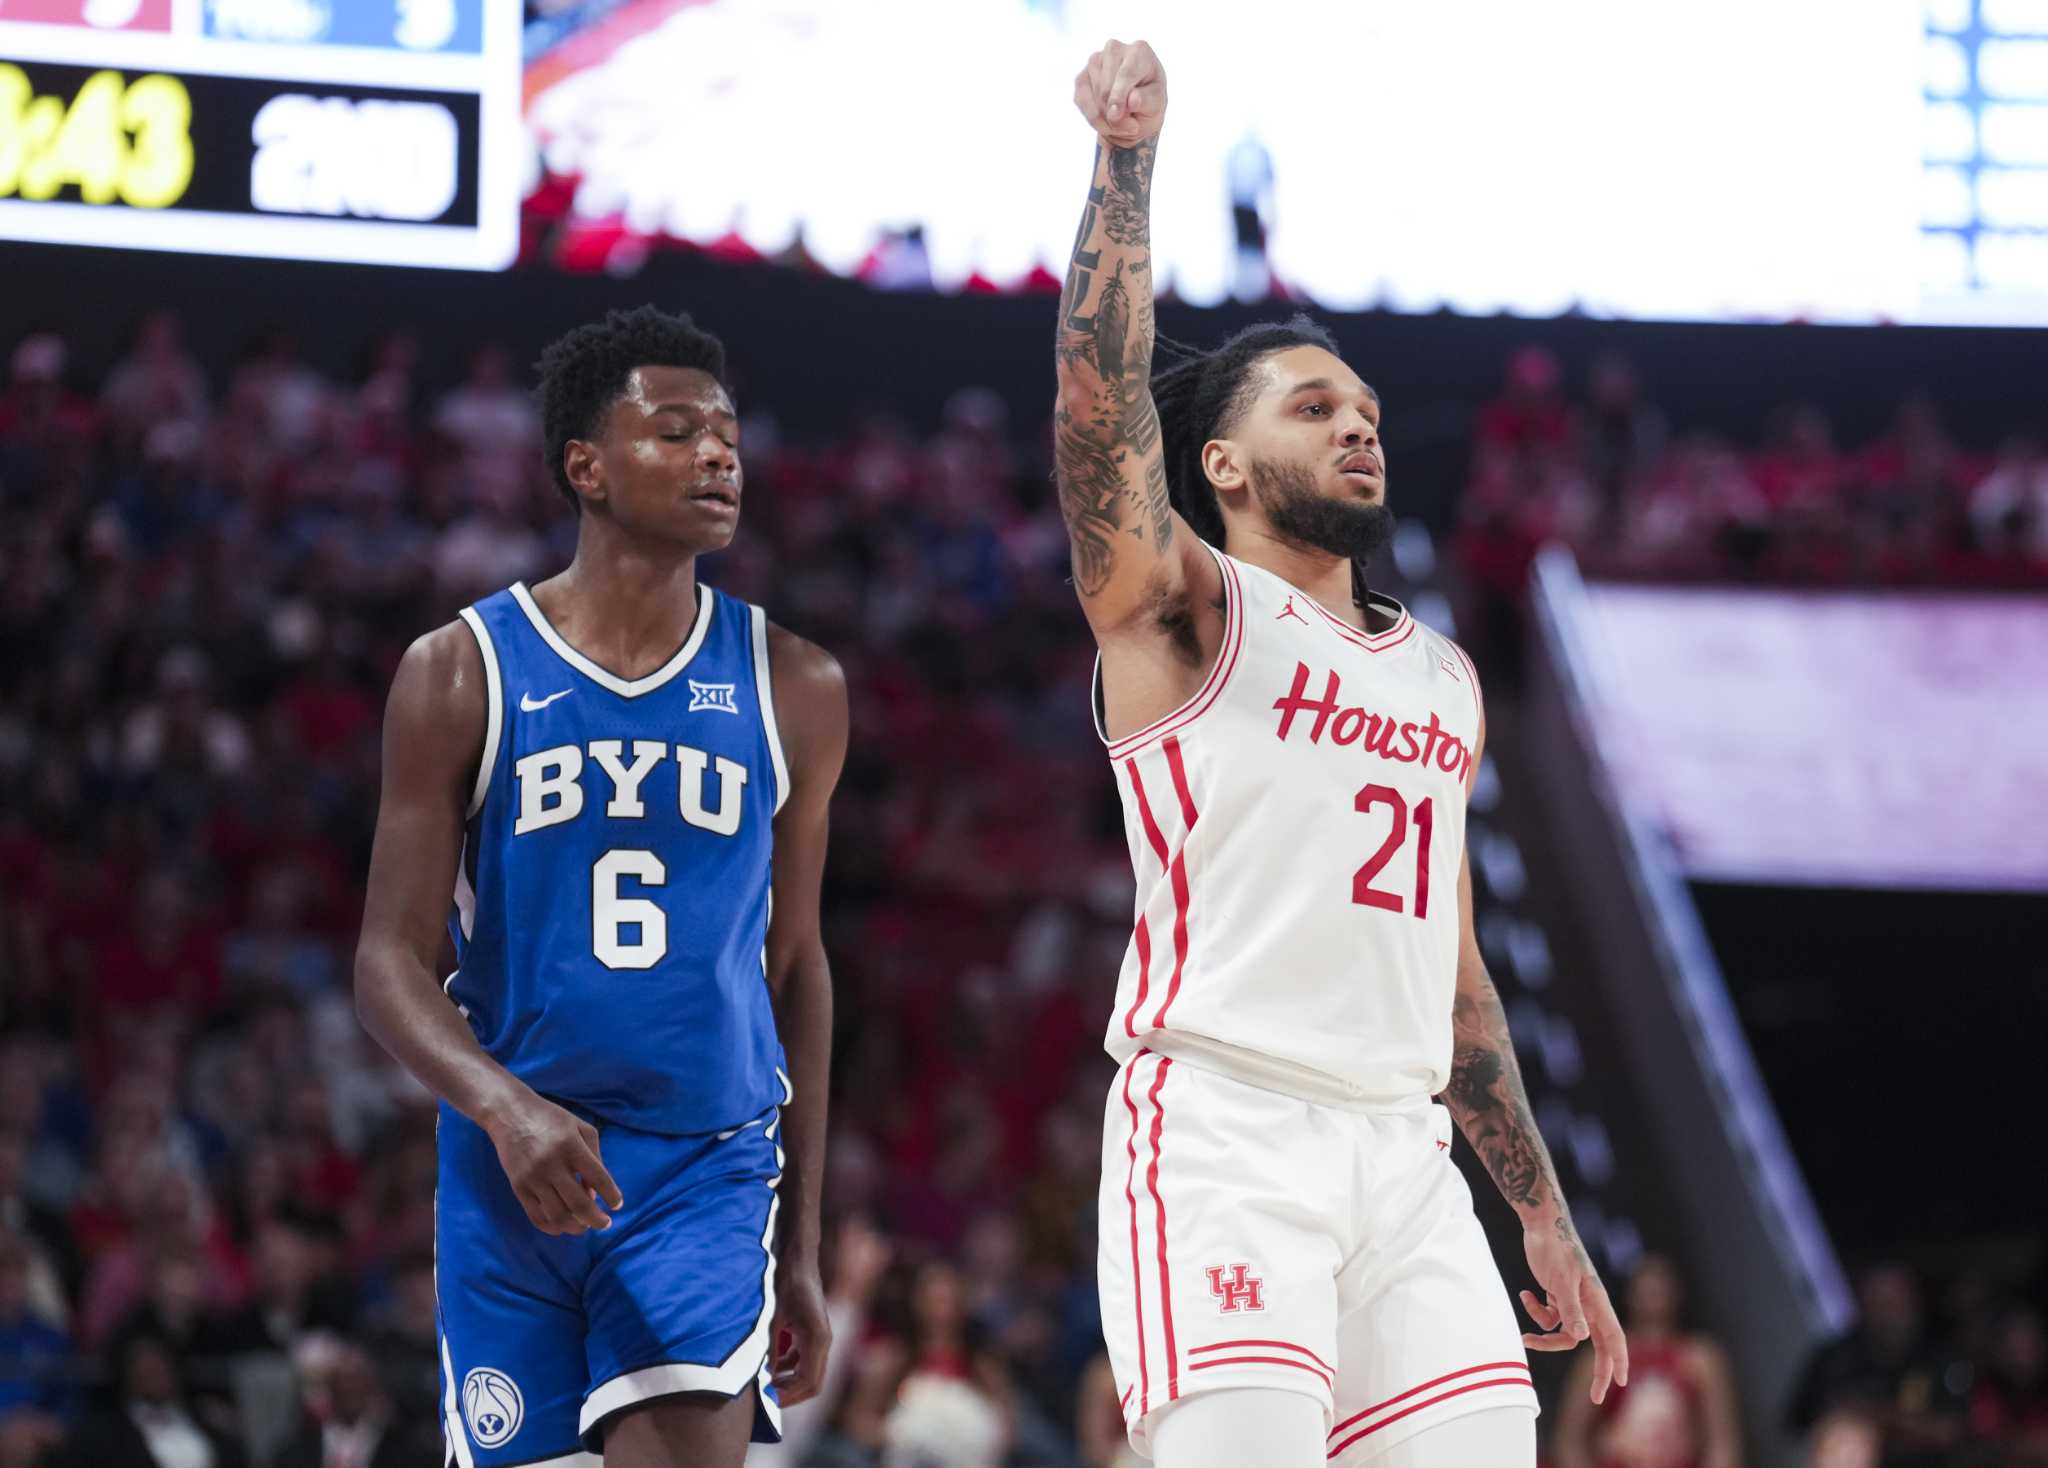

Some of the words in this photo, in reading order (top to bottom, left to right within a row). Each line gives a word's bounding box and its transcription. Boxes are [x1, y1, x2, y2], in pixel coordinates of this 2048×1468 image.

[513, 739, 748, 837] BYU
[1351, 783, 1434, 920] 21
[592, 848, 668, 969] 6
[478, 1413, 504, 1435] Y
